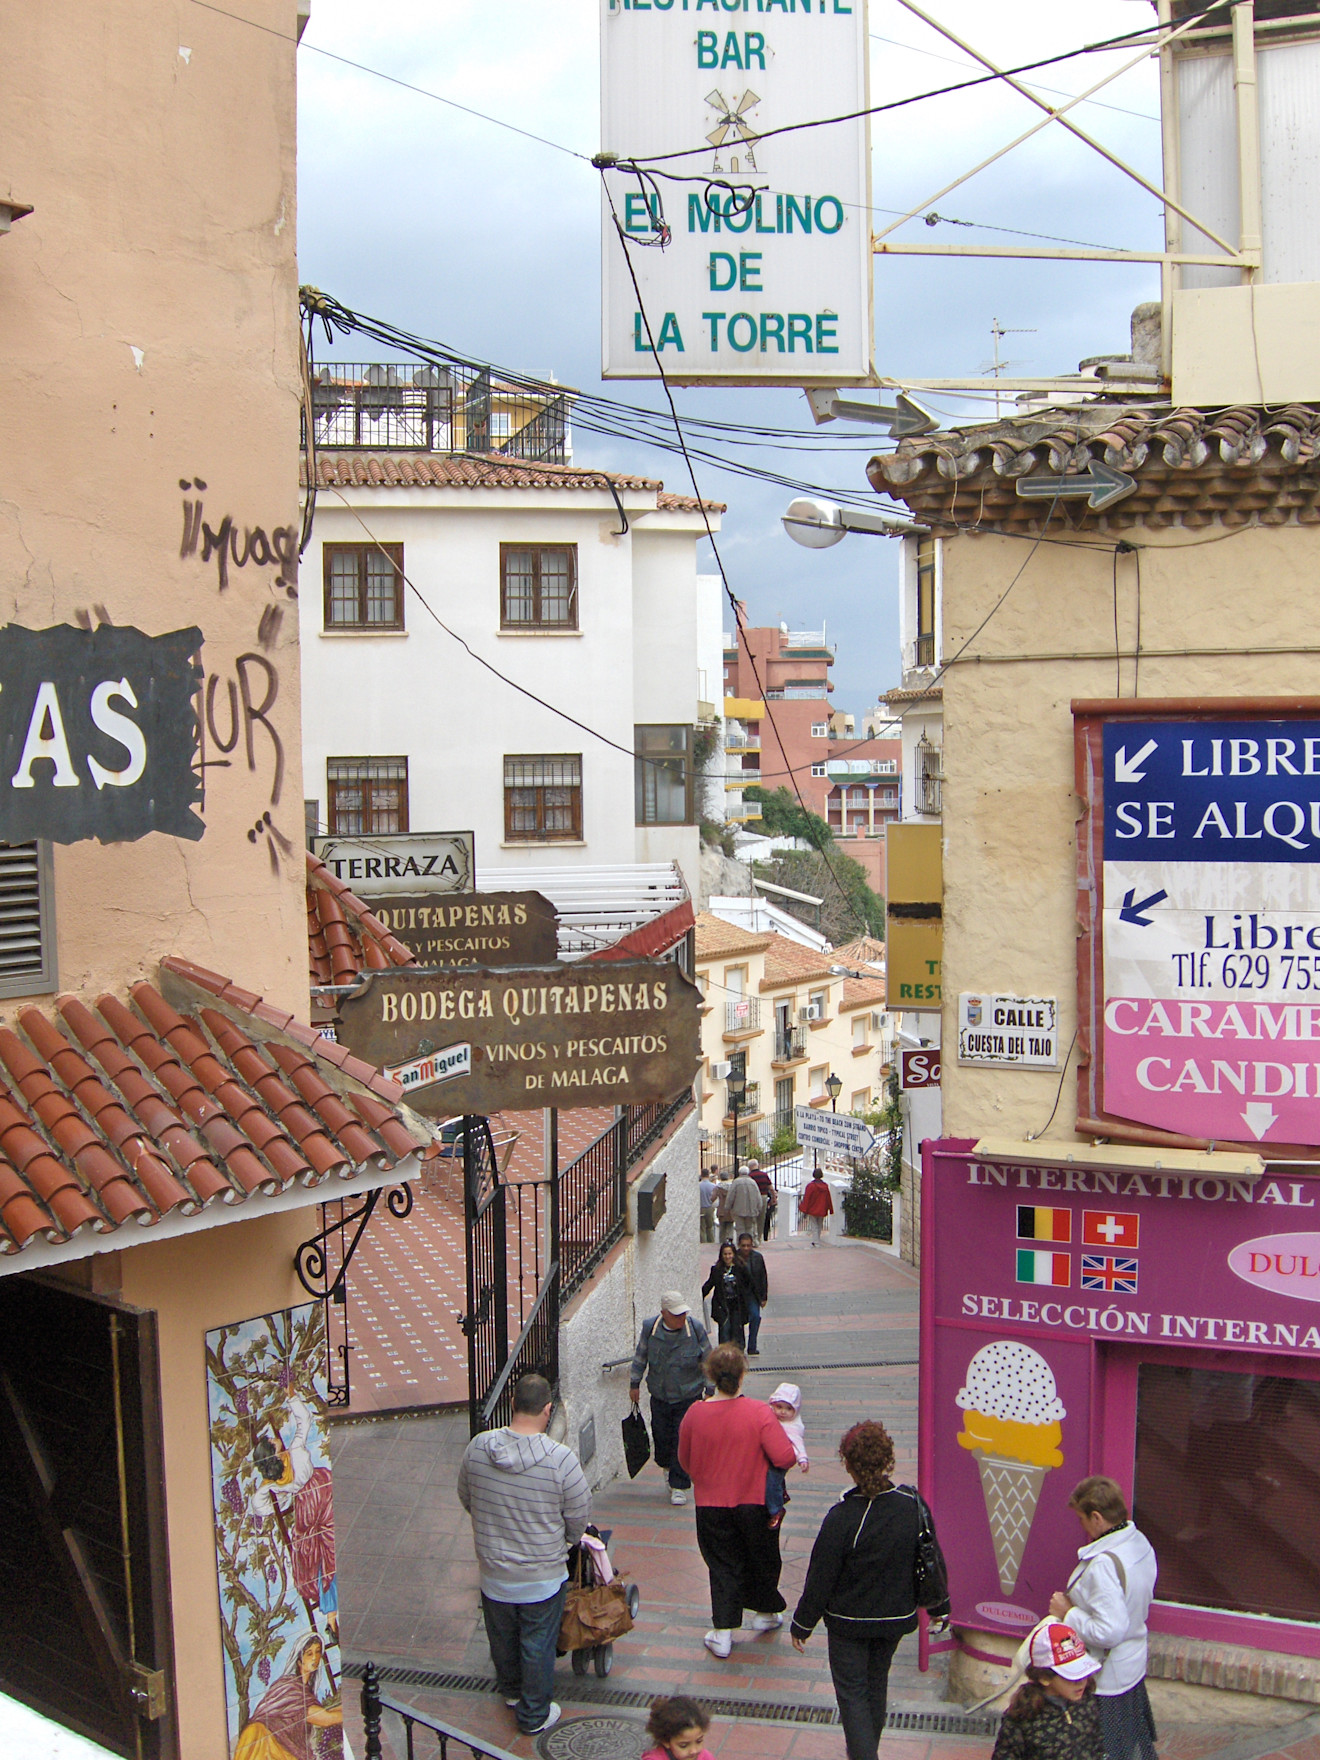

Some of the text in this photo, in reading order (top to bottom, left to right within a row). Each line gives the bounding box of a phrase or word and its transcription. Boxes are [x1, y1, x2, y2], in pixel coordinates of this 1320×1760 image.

[697, 30, 766, 70] BAR
[625, 193, 844, 234] EL MOLINO
[709, 252, 763, 292] DE
[634, 312, 839, 353] LA TORRE
[0, 676, 147, 790] AS
[1115, 801, 1176, 839] SE
[329, 854, 459, 880] TERRAZA
[375, 903, 528, 930] QUITAPENAS
[427, 936, 511, 953] PESCAITOS
[1172, 952, 1212, 988] Tlf.
[1222, 954, 1270, 989] 629
[382, 981, 668, 1026] BODEGA QUITAPENAS
[994, 1008, 1044, 1028] CALLE
[486, 1034, 668, 1062] VINOS Y PESCAITOS
[968, 1033, 1052, 1057] CUESTA DEL TAJO
[526, 1066, 630, 1090] DE MALAGA
[1136, 1056, 1320, 1098] CANDI
[967, 1162, 1315, 1208] INTERNATIONAL
[1248, 1252, 1320, 1277] DUL
[961, 1294, 1151, 1335] SELECCIÓN
[981, 1605, 1036, 1622] DULCEMIEL
